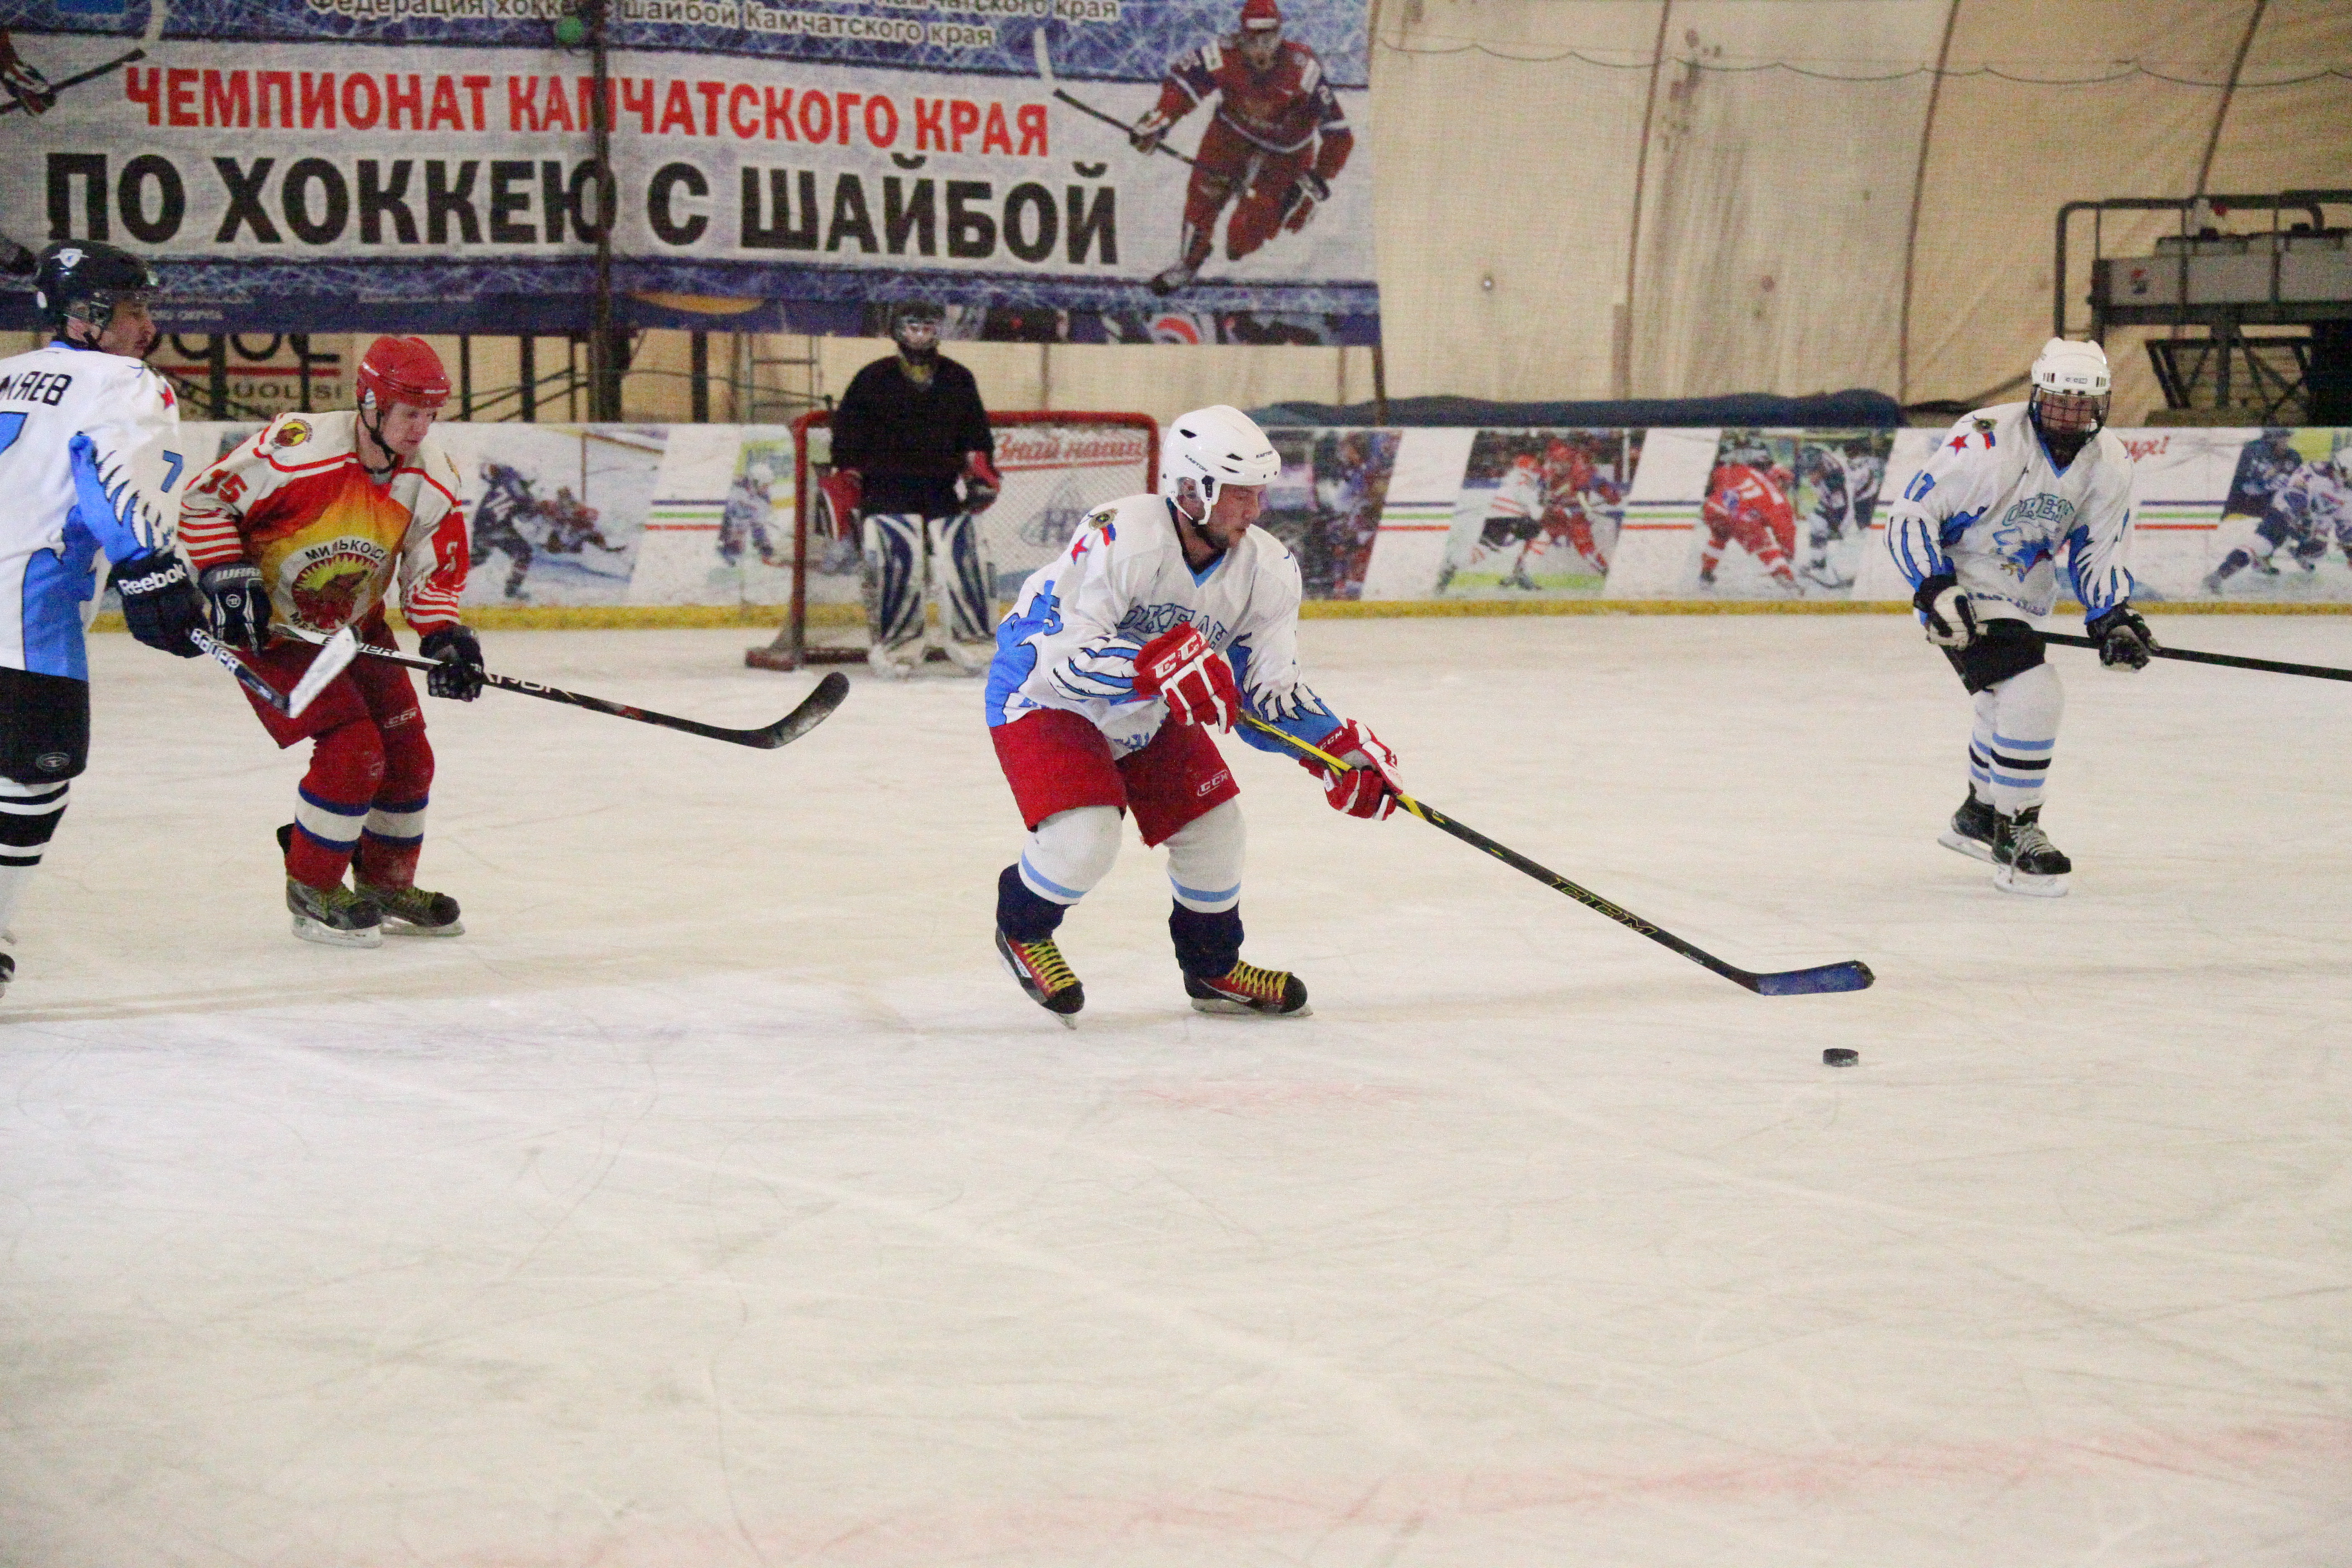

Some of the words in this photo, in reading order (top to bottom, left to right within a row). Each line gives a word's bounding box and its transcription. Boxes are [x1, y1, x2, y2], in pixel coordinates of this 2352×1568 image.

[1057, 0, 1117, 20] края
[497, 0, 588, 16] хокке
[745, 4, 921, 41] Камчатского
[931, 23, 992, 47] края
[125, 67, 491, 131] ЧЕМПИОНАТ
[508, 75, 899, 149] КАМЧАТСКОГО
[915, 97, 1049, 157] КРАЯ
[47, 153, 186, 243] ПО
[212, 157, 617, 245] ХОККЕЮ
[647, 162, 710, 246] С
[741, 152, 1118, 265] ШАЙБОЙ
[1184, 454, 1208, 472] EASTON
[117, 563, 187, 596] Reebok
[1320, 730, 1343, 750] CCM
[1200, 772, 1228, 792] CCM
